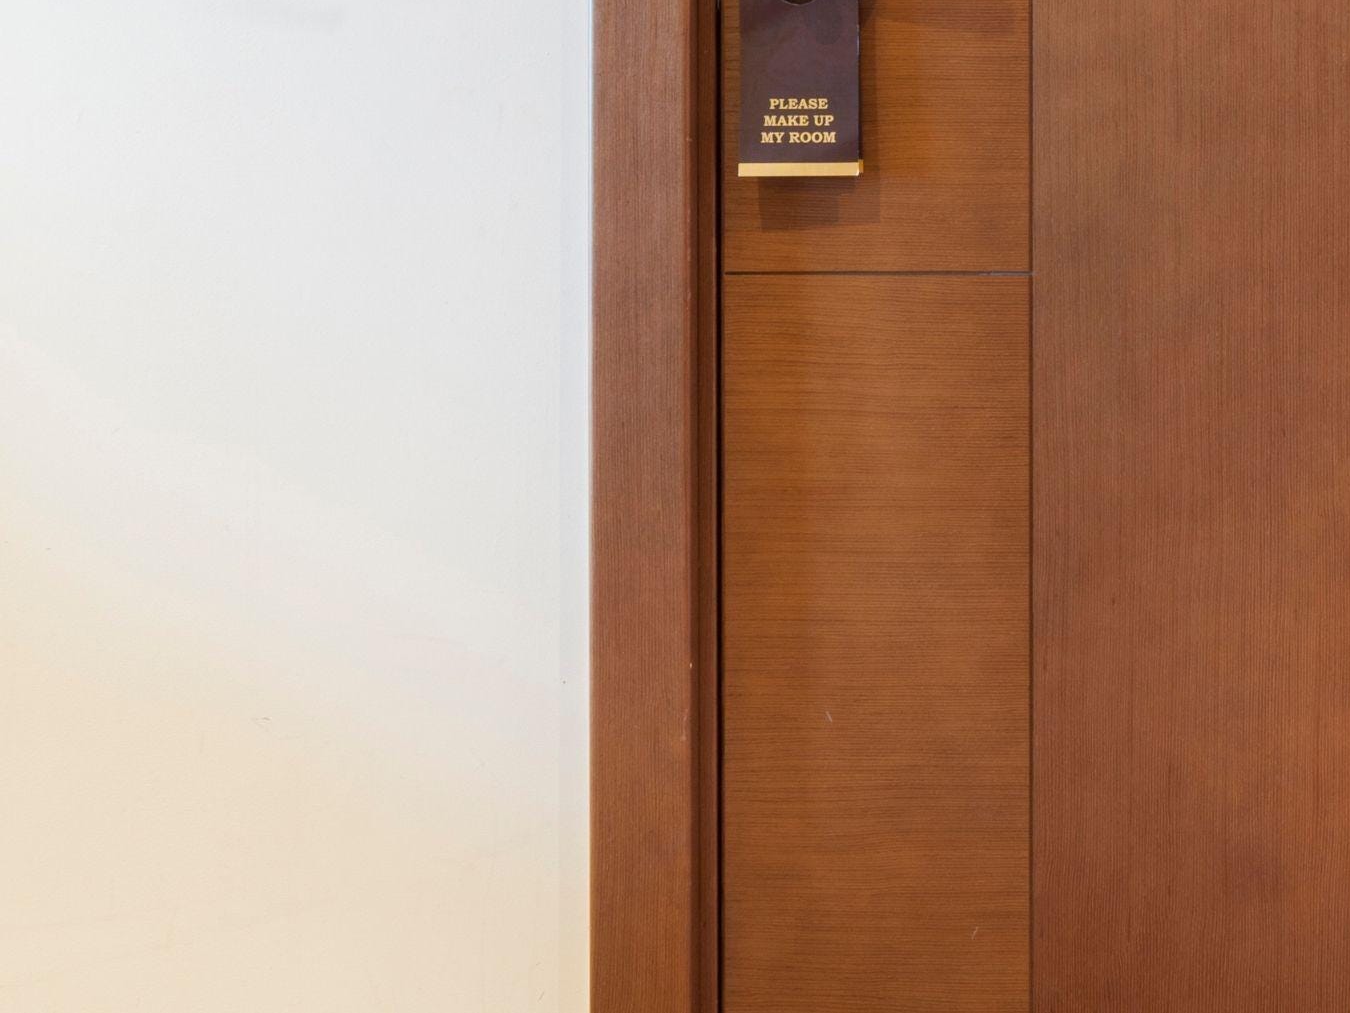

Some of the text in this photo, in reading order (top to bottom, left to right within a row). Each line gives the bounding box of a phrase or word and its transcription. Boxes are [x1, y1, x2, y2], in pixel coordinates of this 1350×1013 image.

[769, 98, 828, 110] PLEASE
[763, 115, 834, 127] MAKE UP
[760, 131, 836, 144] MY ROOM
